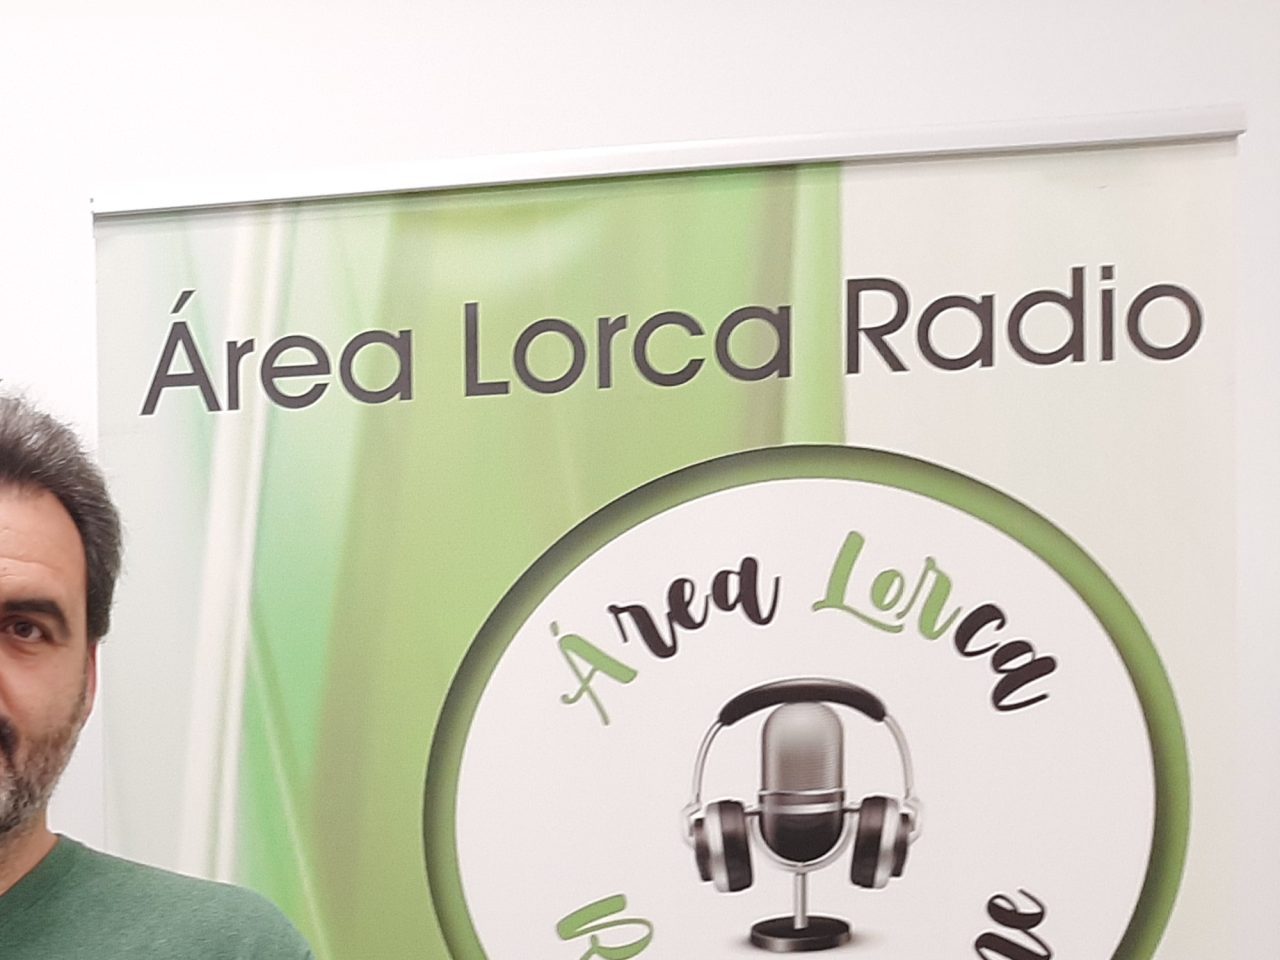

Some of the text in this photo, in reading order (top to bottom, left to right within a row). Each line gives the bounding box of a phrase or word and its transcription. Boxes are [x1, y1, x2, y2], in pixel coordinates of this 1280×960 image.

[141, 265, 1203, 415] Área Lorca Radio
[549, 530, 1058, 726] Área Lorca
